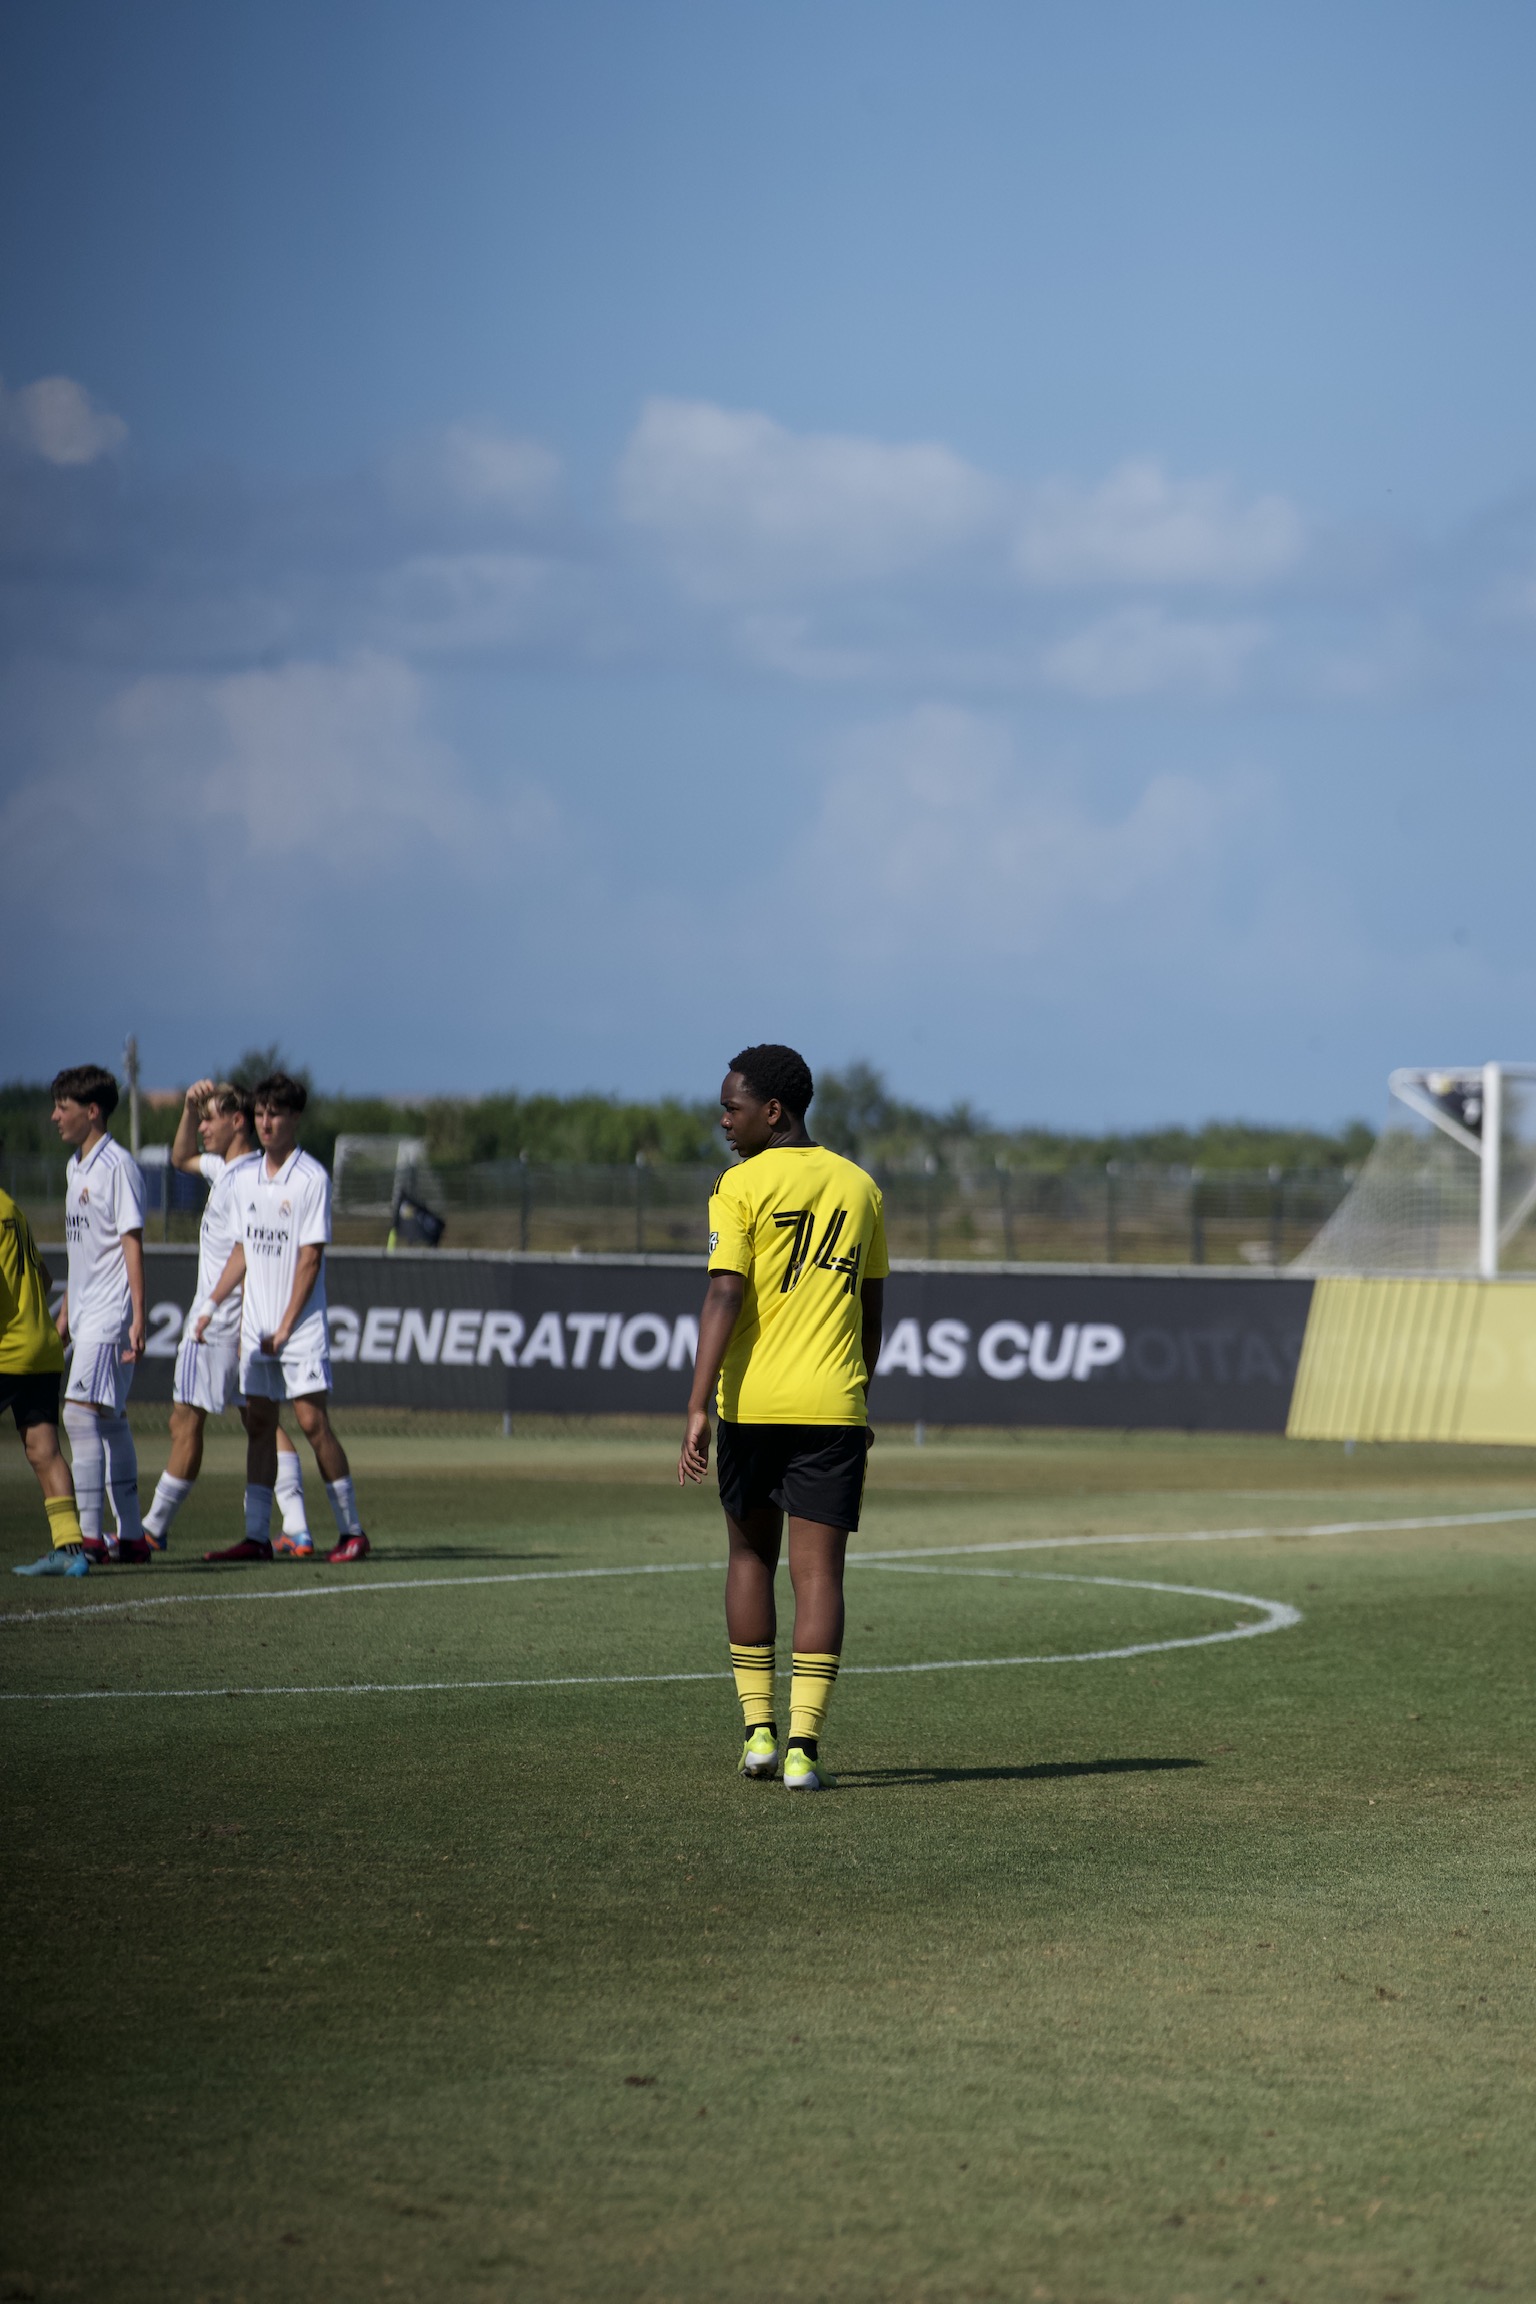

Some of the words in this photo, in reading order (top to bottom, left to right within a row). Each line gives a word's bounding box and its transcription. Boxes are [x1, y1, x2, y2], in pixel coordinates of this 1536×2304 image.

[772, 1209, 863, 1295] 74
[326, 1305, 702, 1372] GENERATION
[876, 1317, 971, 1379] AS
[977, 1319, 1125, 1382] CUP
